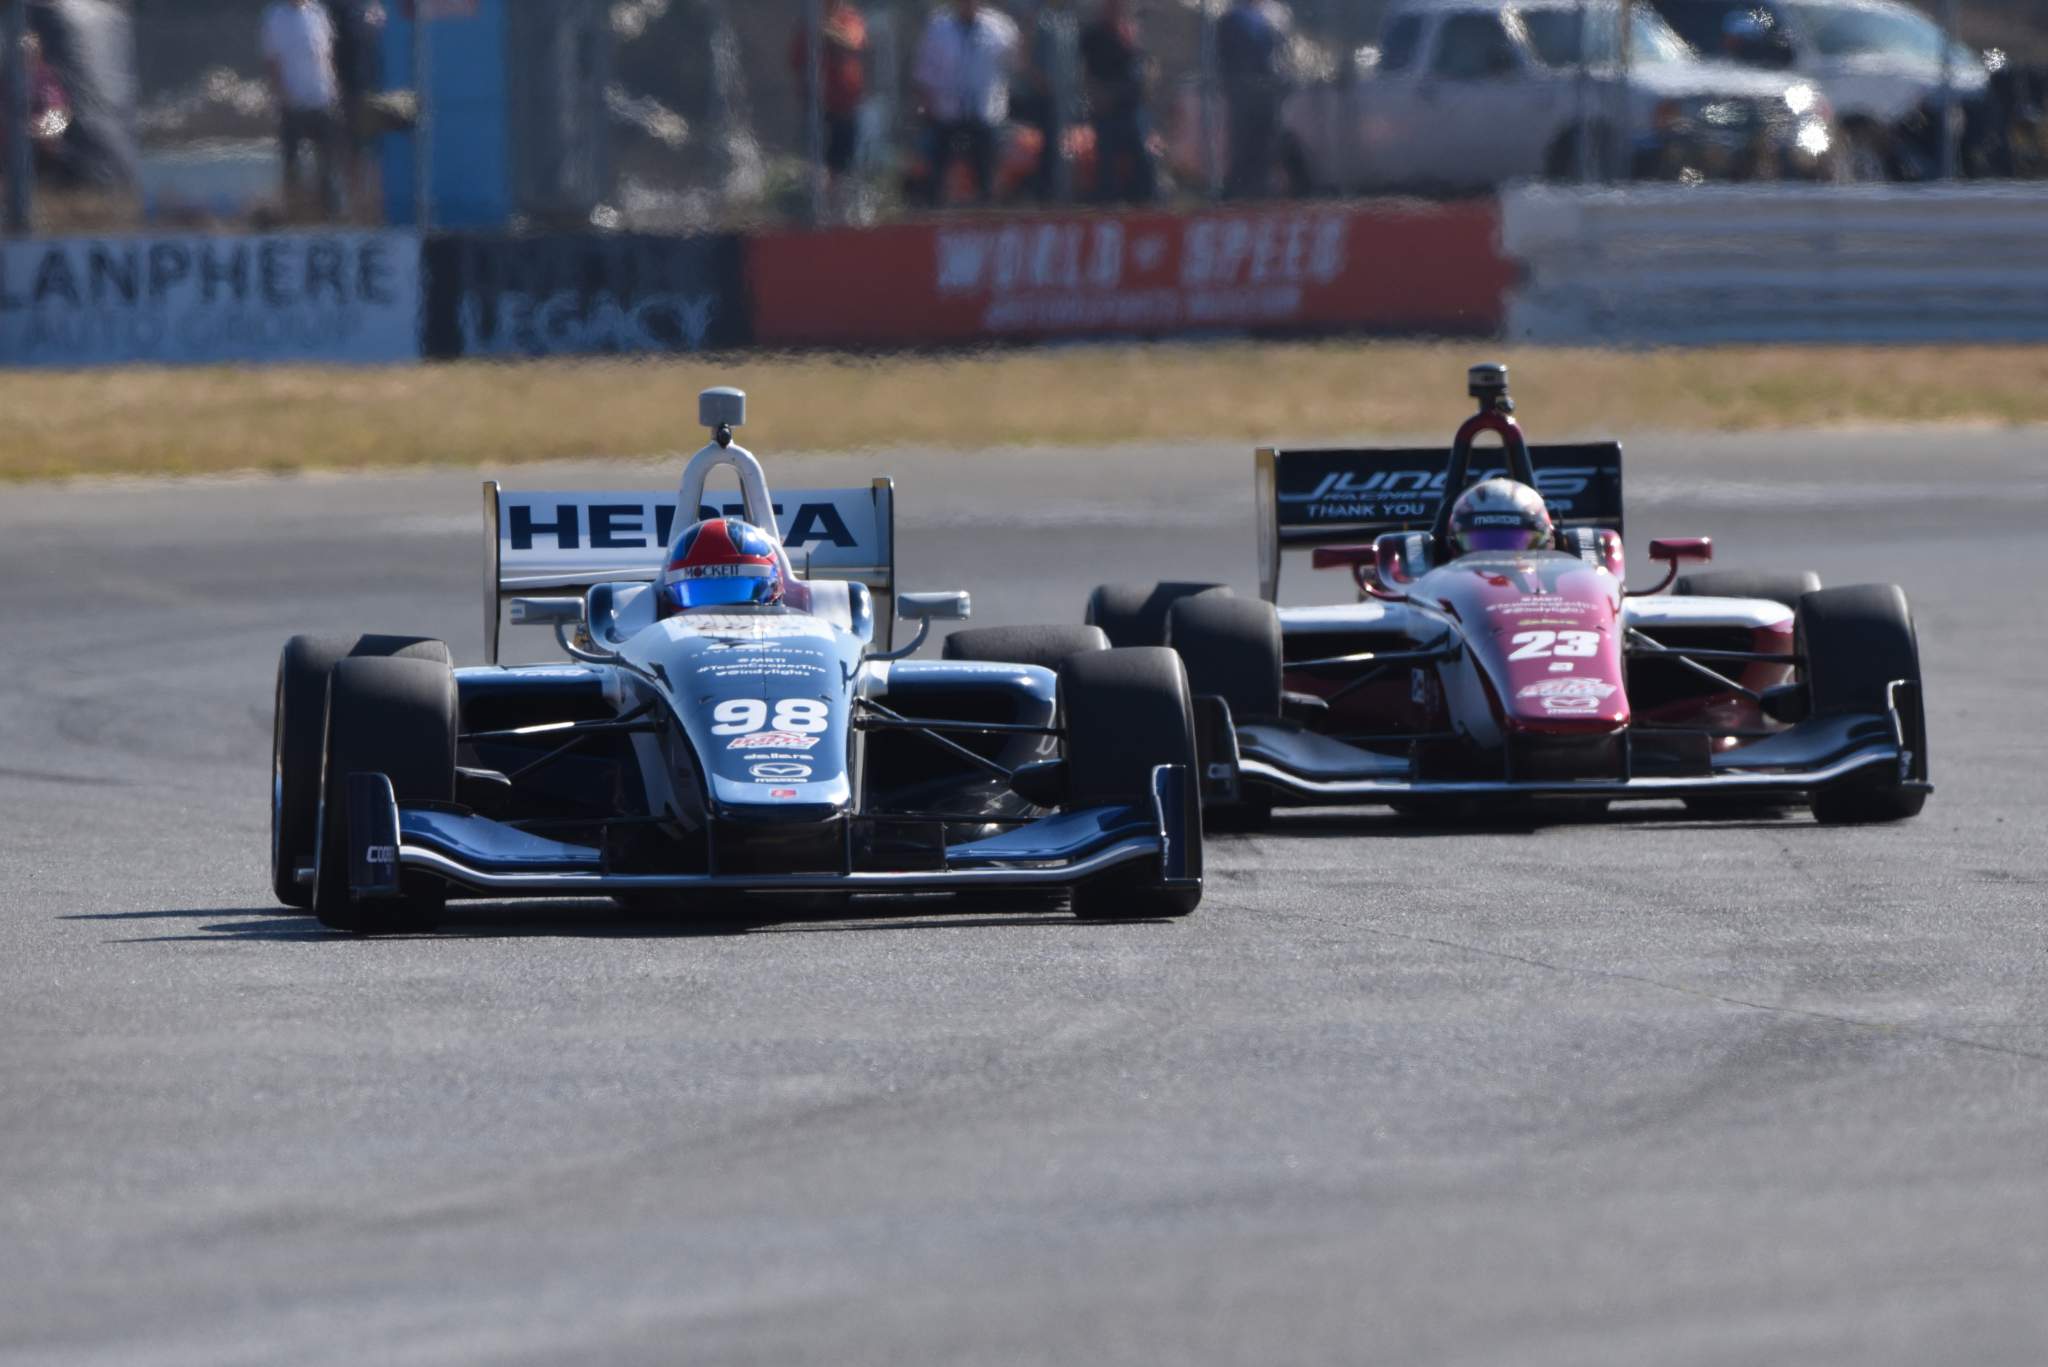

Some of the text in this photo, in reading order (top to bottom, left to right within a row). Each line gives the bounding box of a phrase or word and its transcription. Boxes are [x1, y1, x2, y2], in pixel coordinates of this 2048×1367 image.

[457, 289, 717, 354] LEGACY
[1280, 465, 1599, 502] JUNS
[1306, 502, 1426, 518] THANK YOU
[1507, 630, 1600, 661] 23
[711, 698, 828, 736] 98
